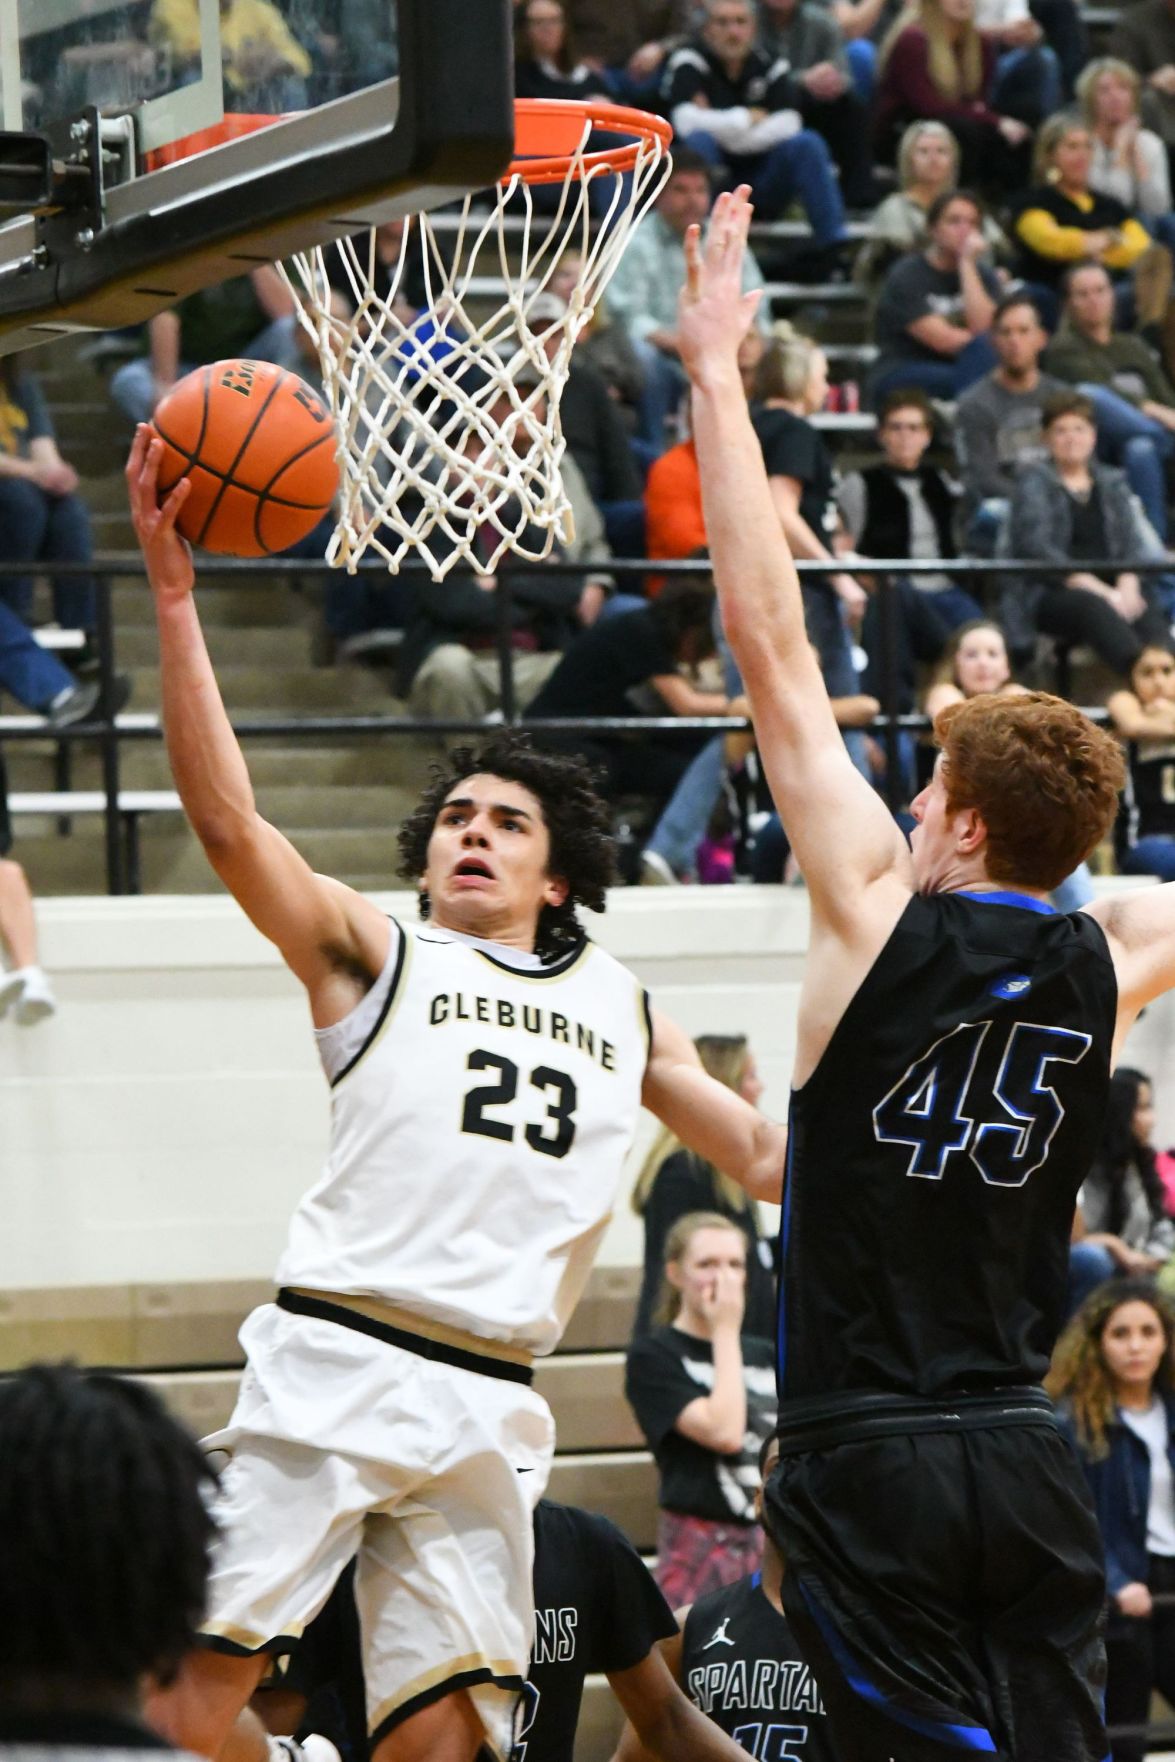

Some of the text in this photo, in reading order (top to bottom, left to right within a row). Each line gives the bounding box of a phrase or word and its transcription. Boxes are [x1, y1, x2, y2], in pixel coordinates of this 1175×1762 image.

[429, 991, 616, 1072] CLEBURNE
[460, 1047, 578, 1160] 23
[872, 1019, 1093, 1188] 45
[687, 1658, 828, 1716] SPARTA
